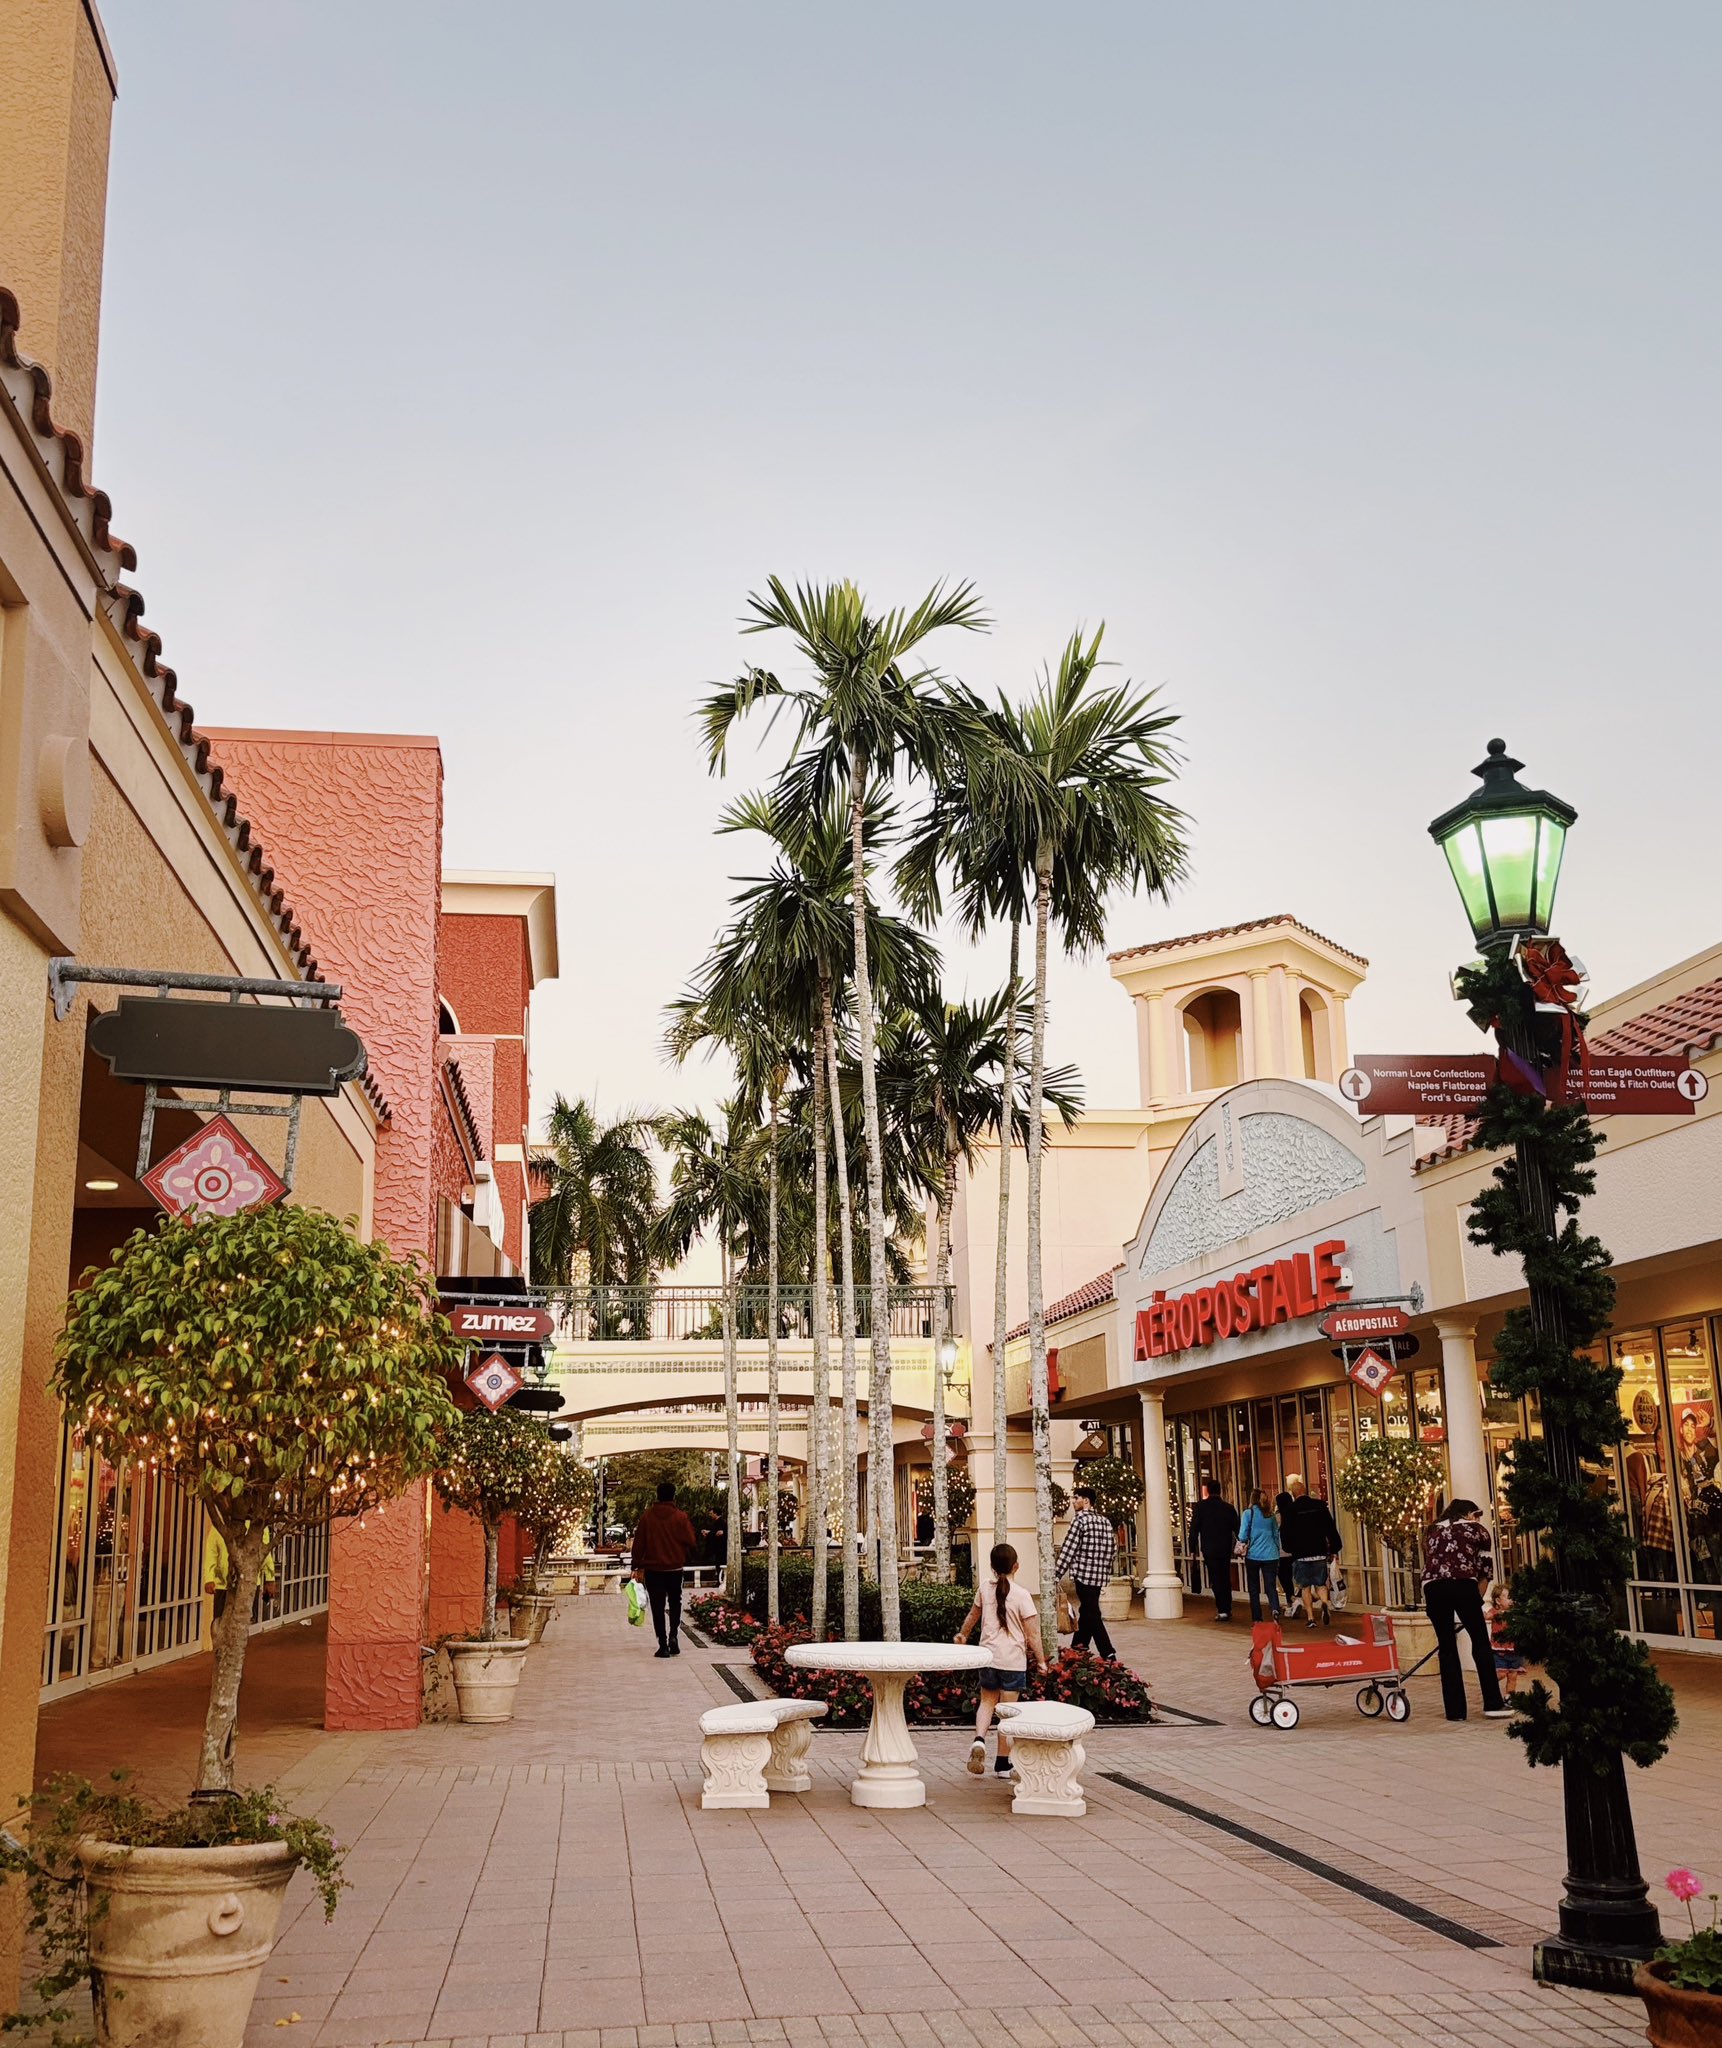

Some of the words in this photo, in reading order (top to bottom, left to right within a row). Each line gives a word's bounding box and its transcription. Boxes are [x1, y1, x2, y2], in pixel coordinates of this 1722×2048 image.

[1373, 1069, 1408, 1078] Norman
[1409, 1069, 1432, 1078] Love
[1433, 1069, 1486, 1078] Confections
[1607, 1067, 1633, 1078] Eagle
[1634, 1068, 1676, 1077] Outfitters
[1407, 1081, 1440, 1091] Naples
[1442, 1081, 1487, 1090] Flatbread
[1566, 1079, 1618, 1088] Aberrombie
[1619, 1080, 1627, 1089] &
[1628, 1080, 1649, 1089] Fitch
[1650, 1080, 1676, 1089] Outlet
[1421, 1093, 1452, 1102] Ford's
[1134, 1240, 1349, 1361] AÉROPOSTALE
[461, 1313, 537, 1332] zumiez
[1335, 1316, 1399, 1332] AÉROPOSTALE
